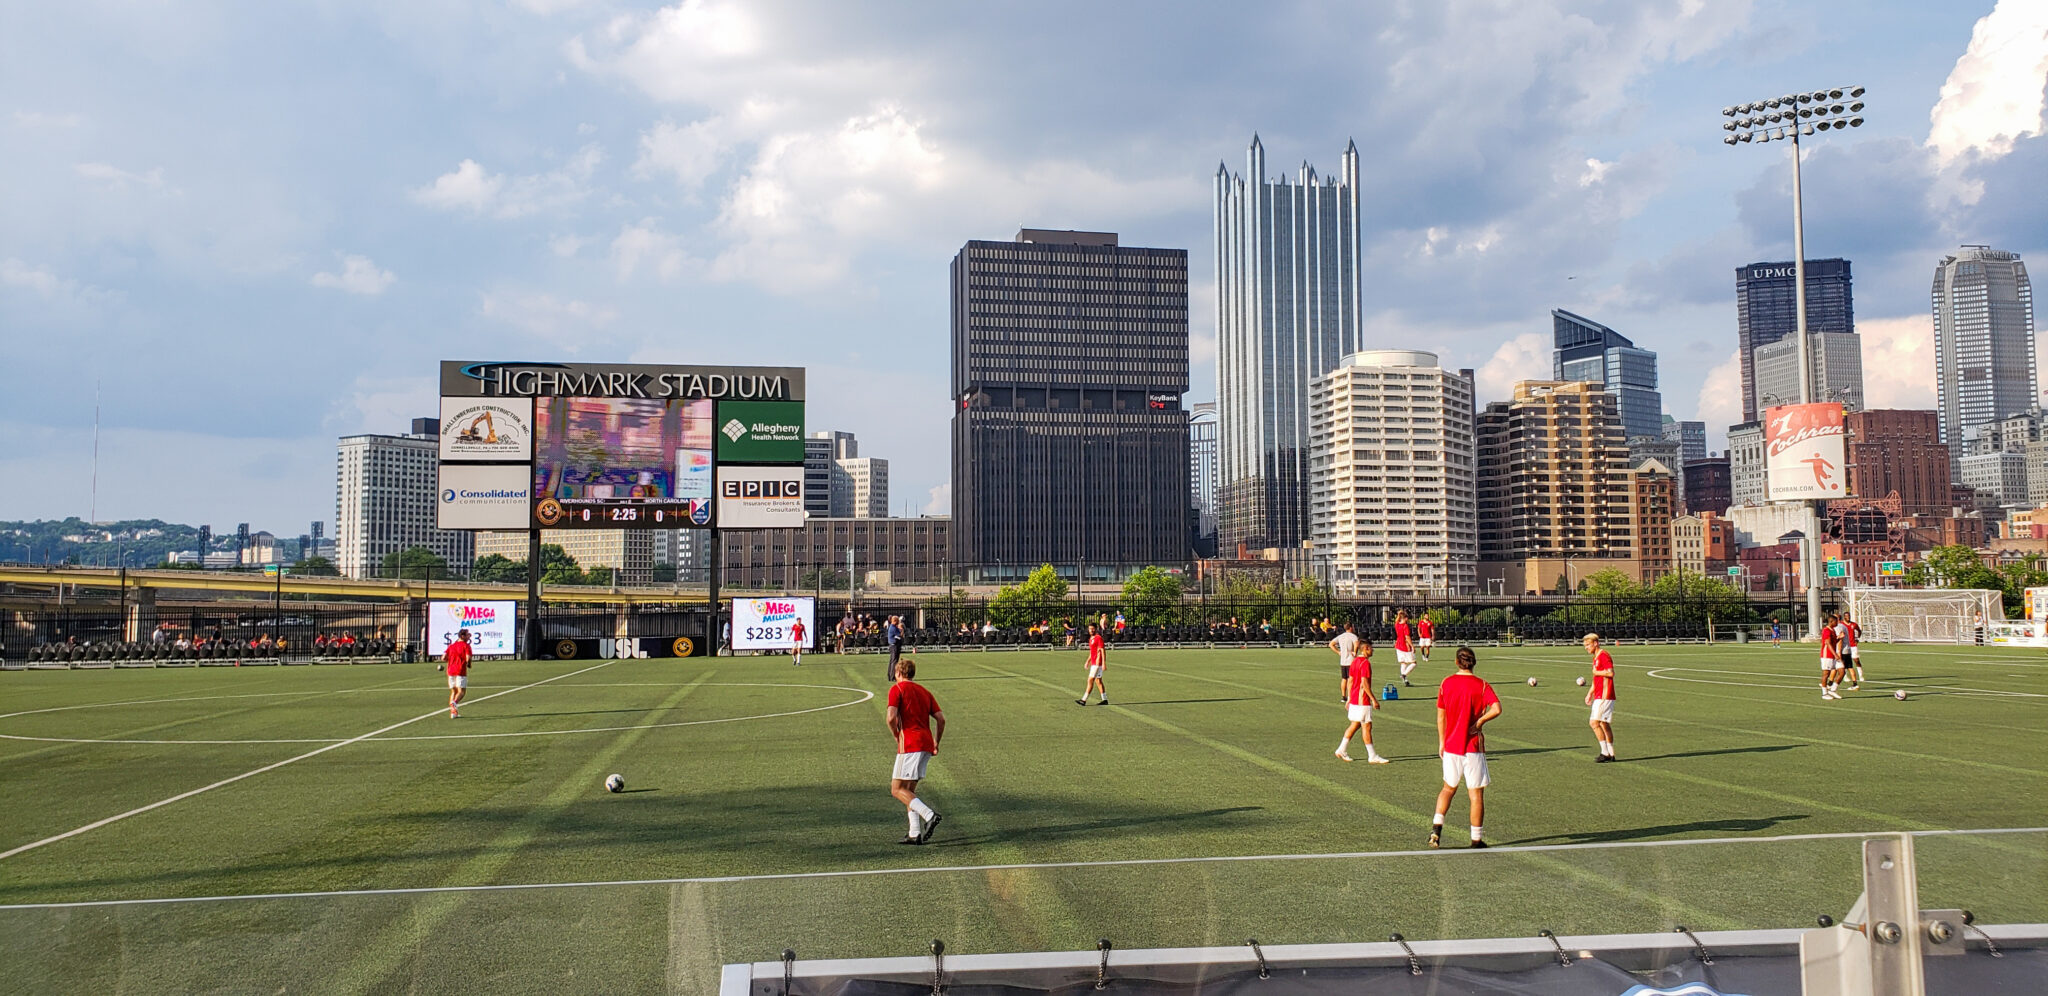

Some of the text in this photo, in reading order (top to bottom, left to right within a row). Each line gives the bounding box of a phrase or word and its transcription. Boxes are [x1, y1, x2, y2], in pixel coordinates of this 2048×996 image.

[1753, 267, 1797, 279] UPMC
[478, 366, 783, 398] HIGHMARK STADIUM
[1149, 394, 1178, 402] KeyBank
[751, 423, 800, 435] Allegheny
[1771, 411, 1794, 437] #1
[1767, 425, 1843, 454] Cochran
[459, 489, 527, 498] Consolidated
[725, 481, 798, 496] EPIC
[583, 508, 591, 521] 0
[612, 508, 637, 521] 2:25
[655, 510, 664, 522] 0
[463, 606, 495, 619] MEGA
[765, 601, 795, 615] MEGA
[746, 626, 783, 642] $283
